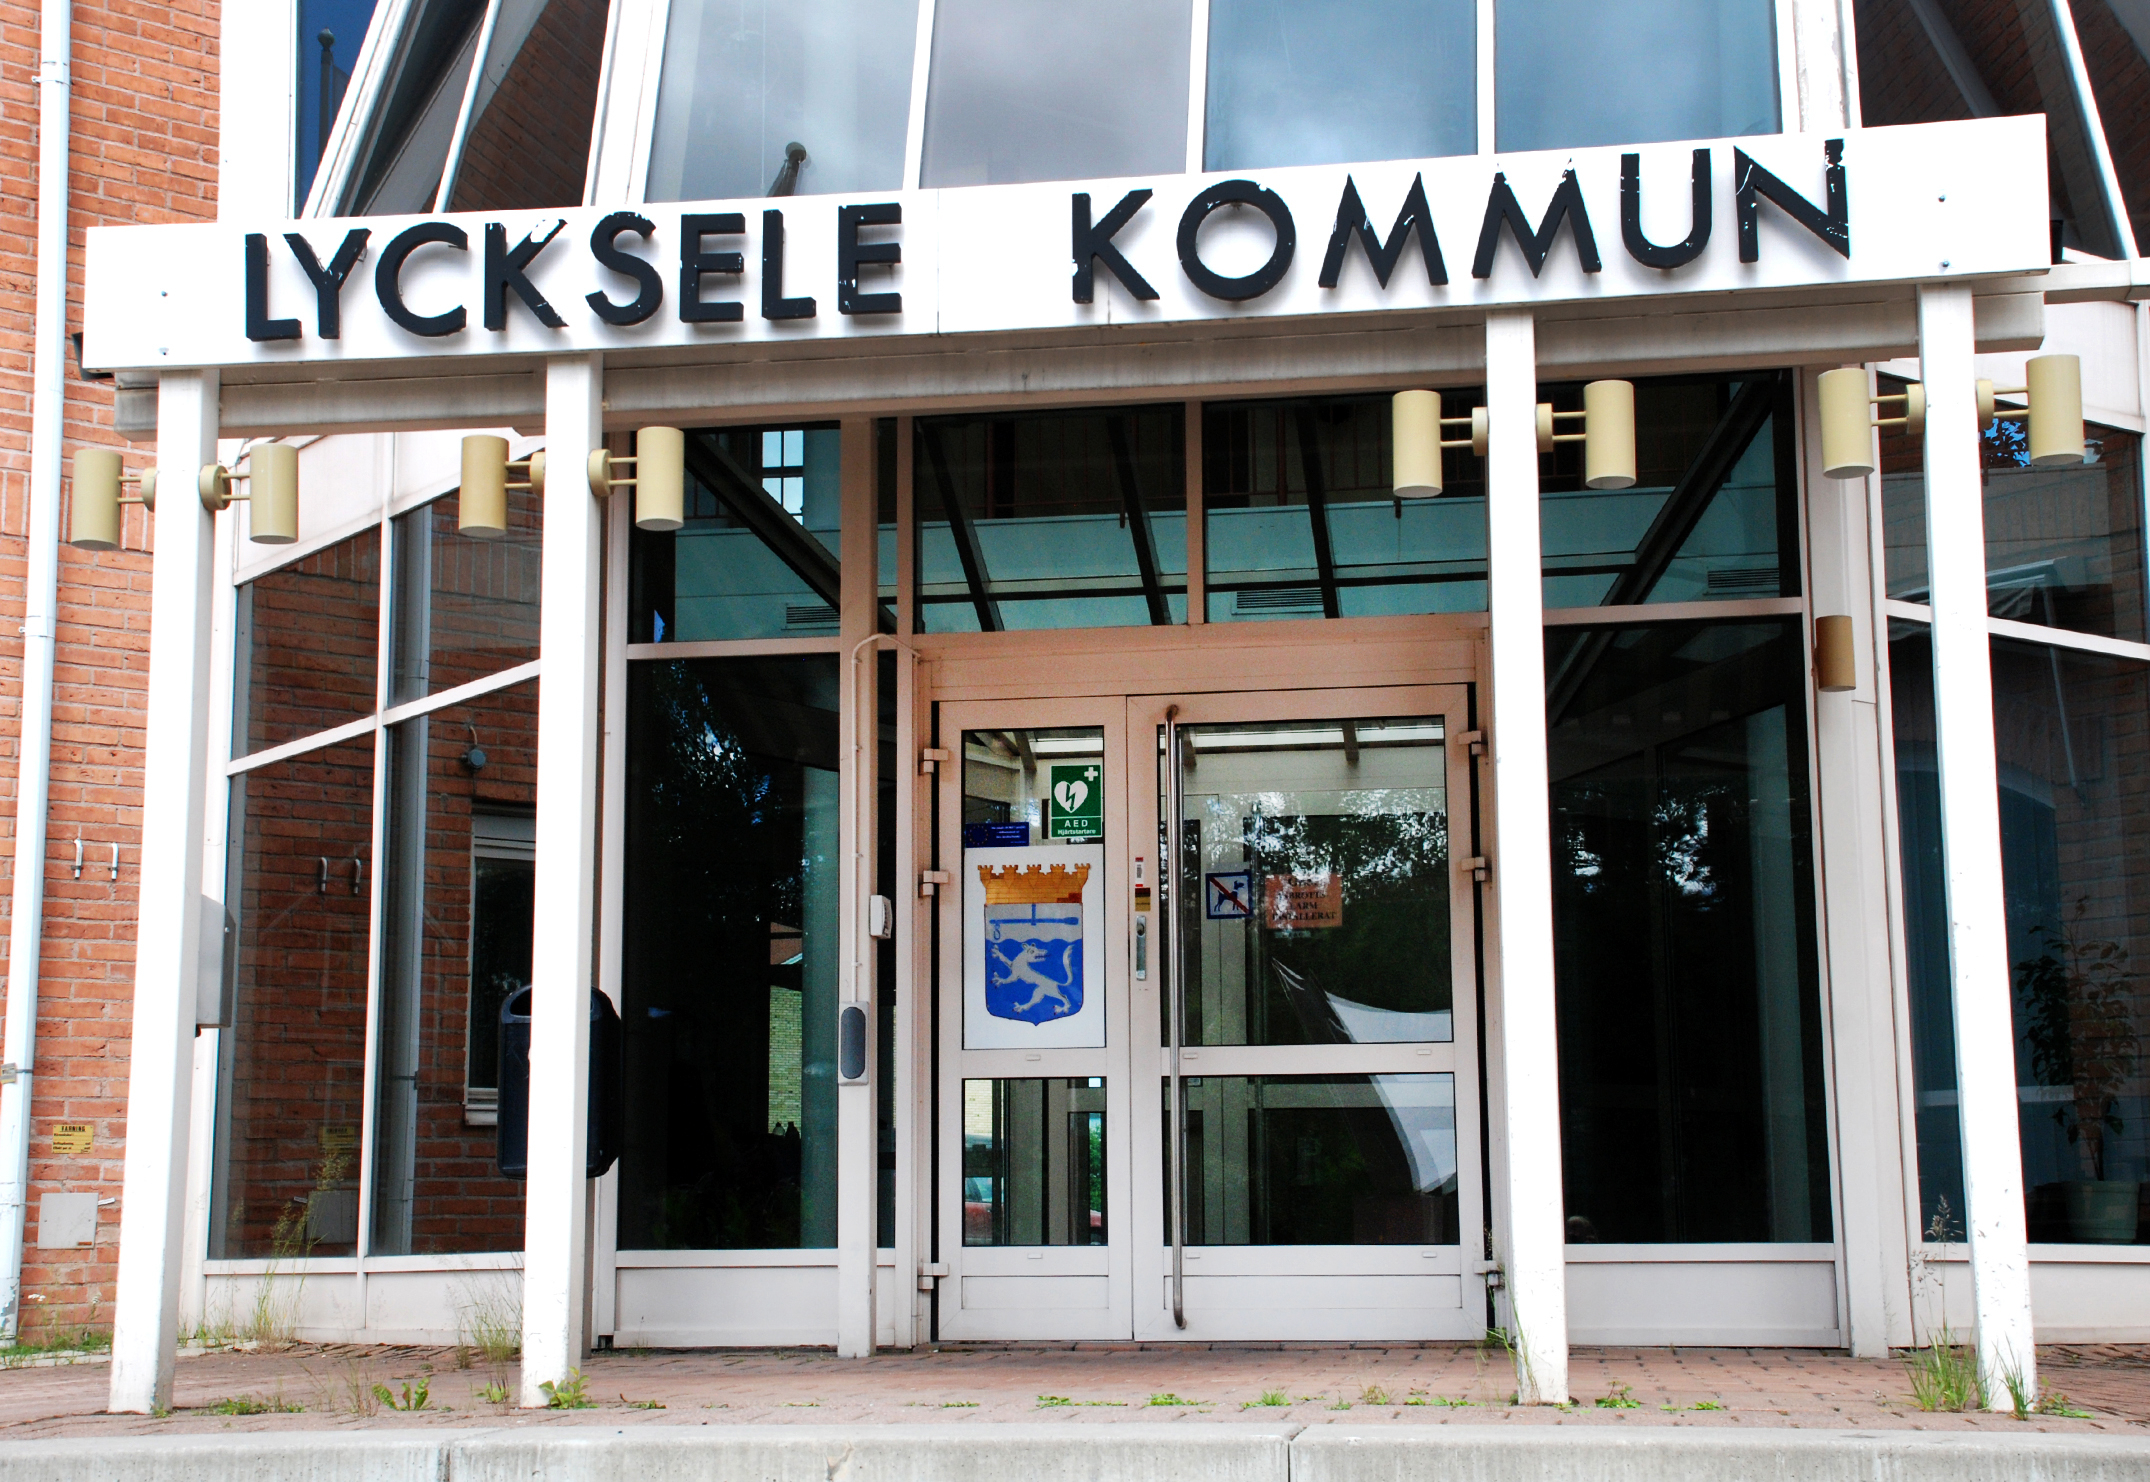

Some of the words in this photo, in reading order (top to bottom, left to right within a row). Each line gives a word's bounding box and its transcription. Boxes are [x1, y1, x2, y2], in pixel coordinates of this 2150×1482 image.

[244, 202, 902, 342] LYCKSELE
[1071, 138, 1850, 304] KOMMUN
[1064, 820, 1088, 828] AED
